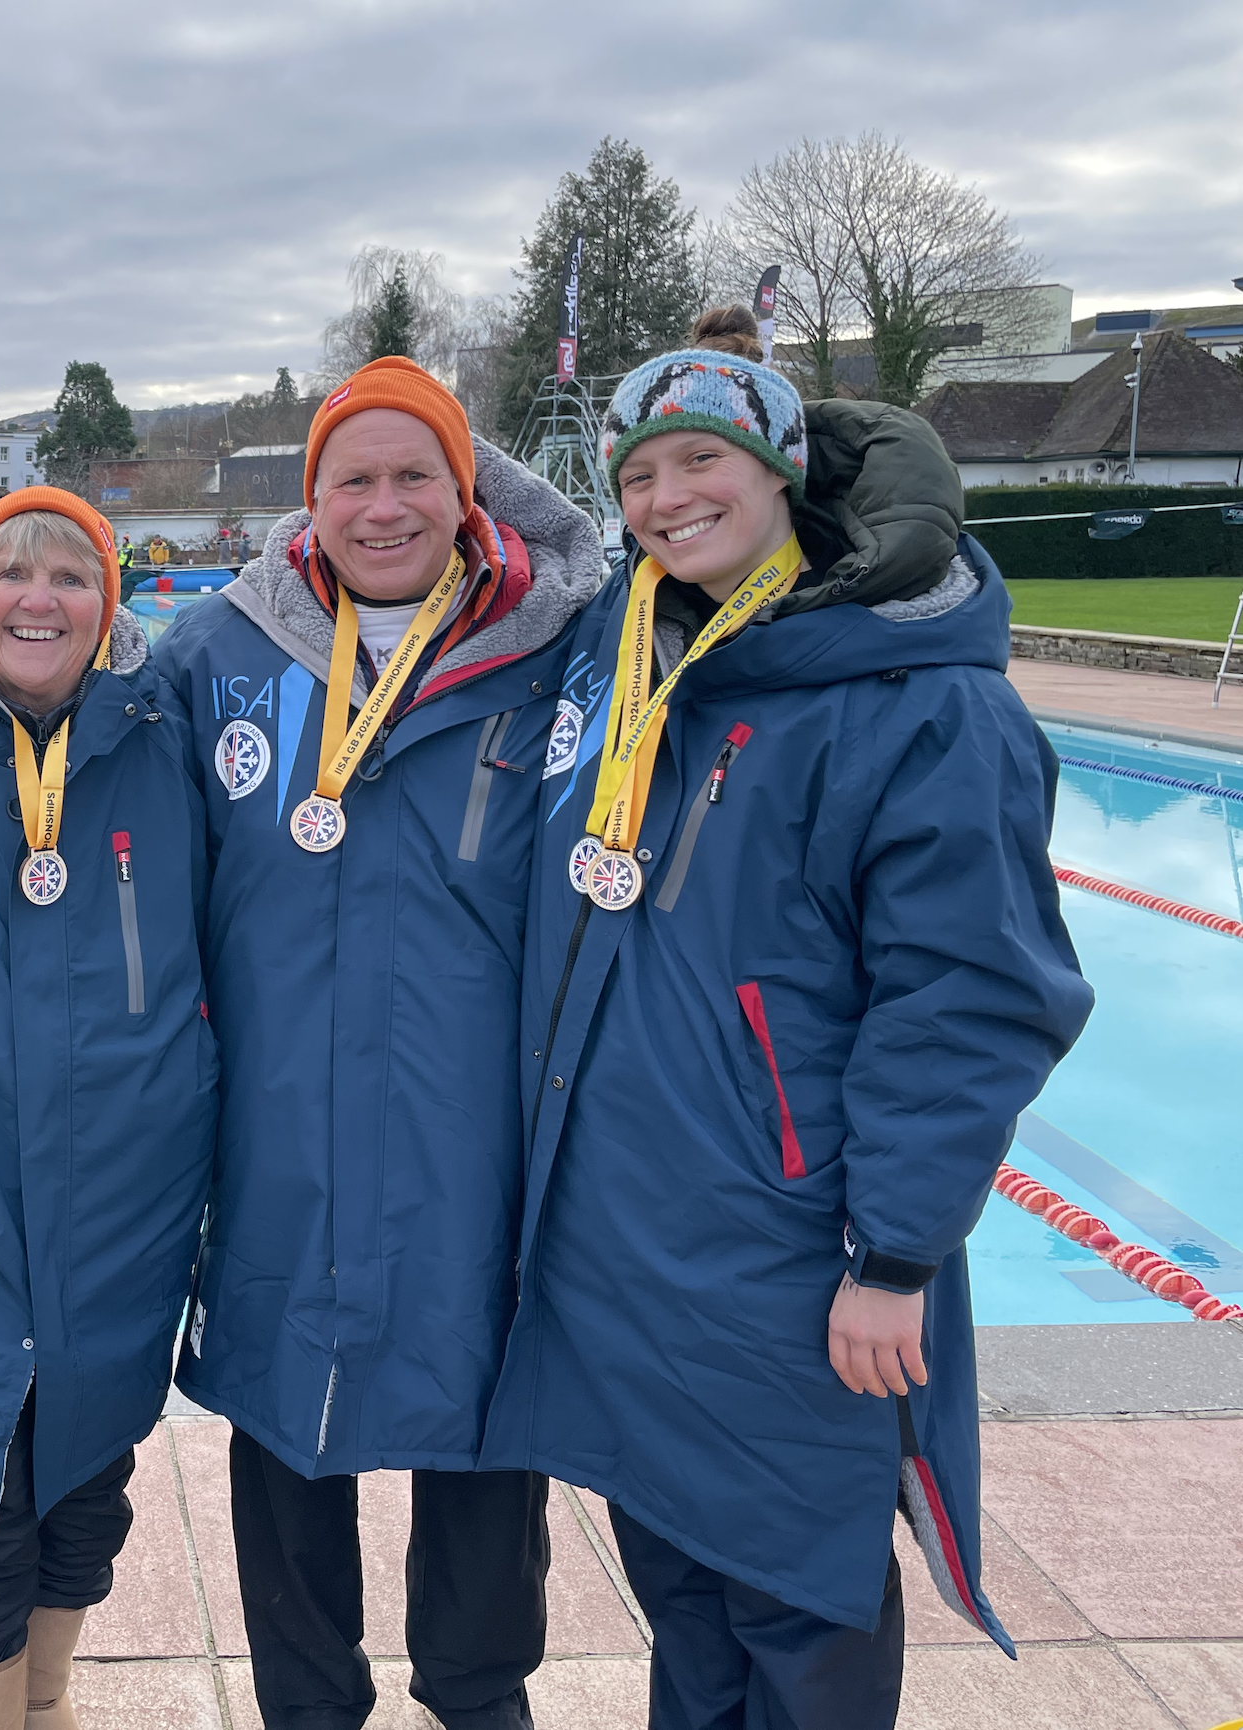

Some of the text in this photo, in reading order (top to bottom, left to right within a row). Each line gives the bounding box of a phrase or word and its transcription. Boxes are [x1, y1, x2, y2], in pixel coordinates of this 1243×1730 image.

[560, 342, 574, 372] red
[329, 386, 350, 407] red
[750, 565, 780, 589] IISA
[427, 597, 444, 614] IISA
[440, 582, 451, 596] GB
[732, 591, 753, 610] GB
[701, 610, 734, 642] 2024
[632, 599, 646, 698] CHAMPIONSHIPS
[212, 675, 273, 720] IISA
[334, 633, 421, 776] IISA GB 2024 CHAMPIONSHIPS
[620, 645, 702, 764] CHAMPIONSHIPS
[236, 723, 262, 741] BRITAIN
[304, 799, 322, 808] GREAT
[42, 792, 56, 850] PIONSHIPS
[595, 853, 635, 869] GREAT BRITAIN
